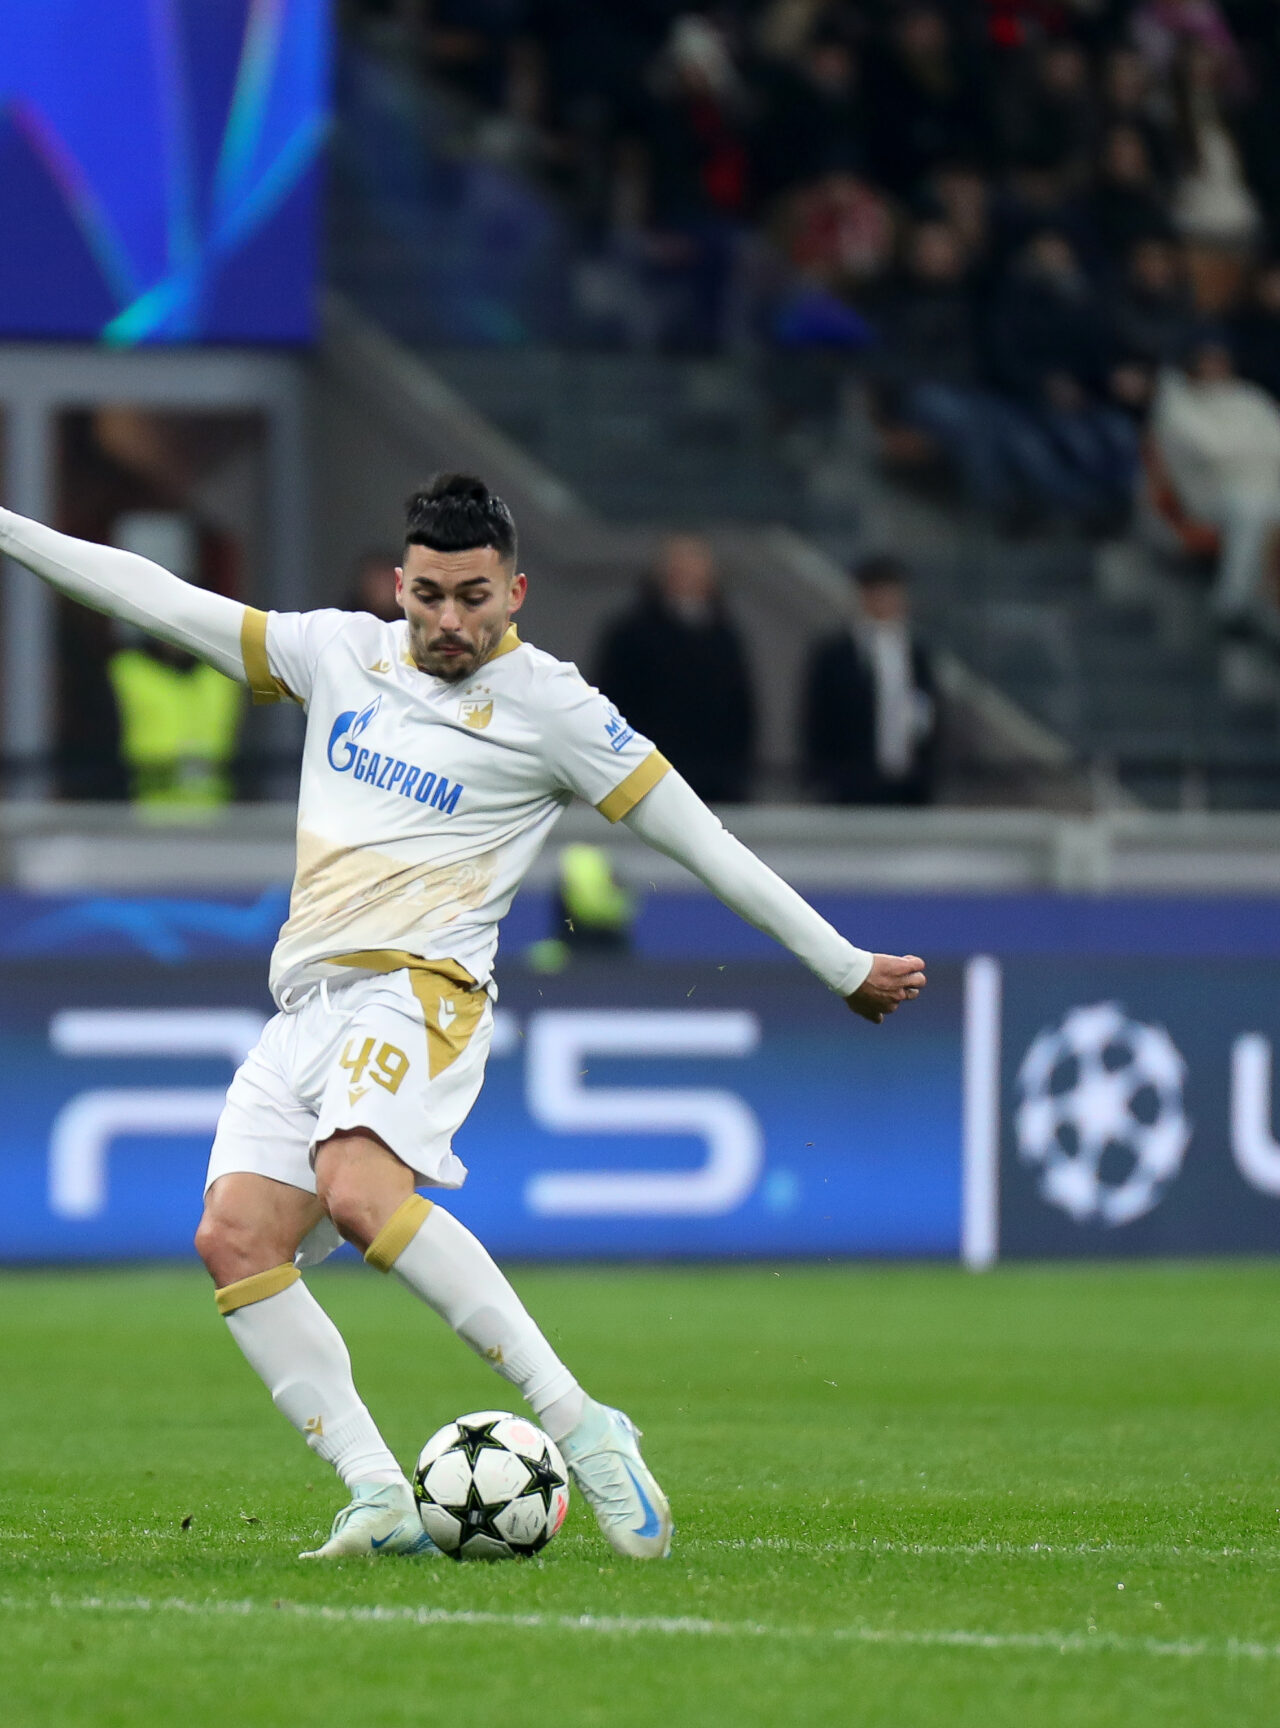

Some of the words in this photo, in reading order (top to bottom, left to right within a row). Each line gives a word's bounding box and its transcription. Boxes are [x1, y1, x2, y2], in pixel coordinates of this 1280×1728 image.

[353, 746, 464, 815] GAZPROM
[339, 1036, 410, 1095] 49
[48, 1007, 762, 1219] P5
